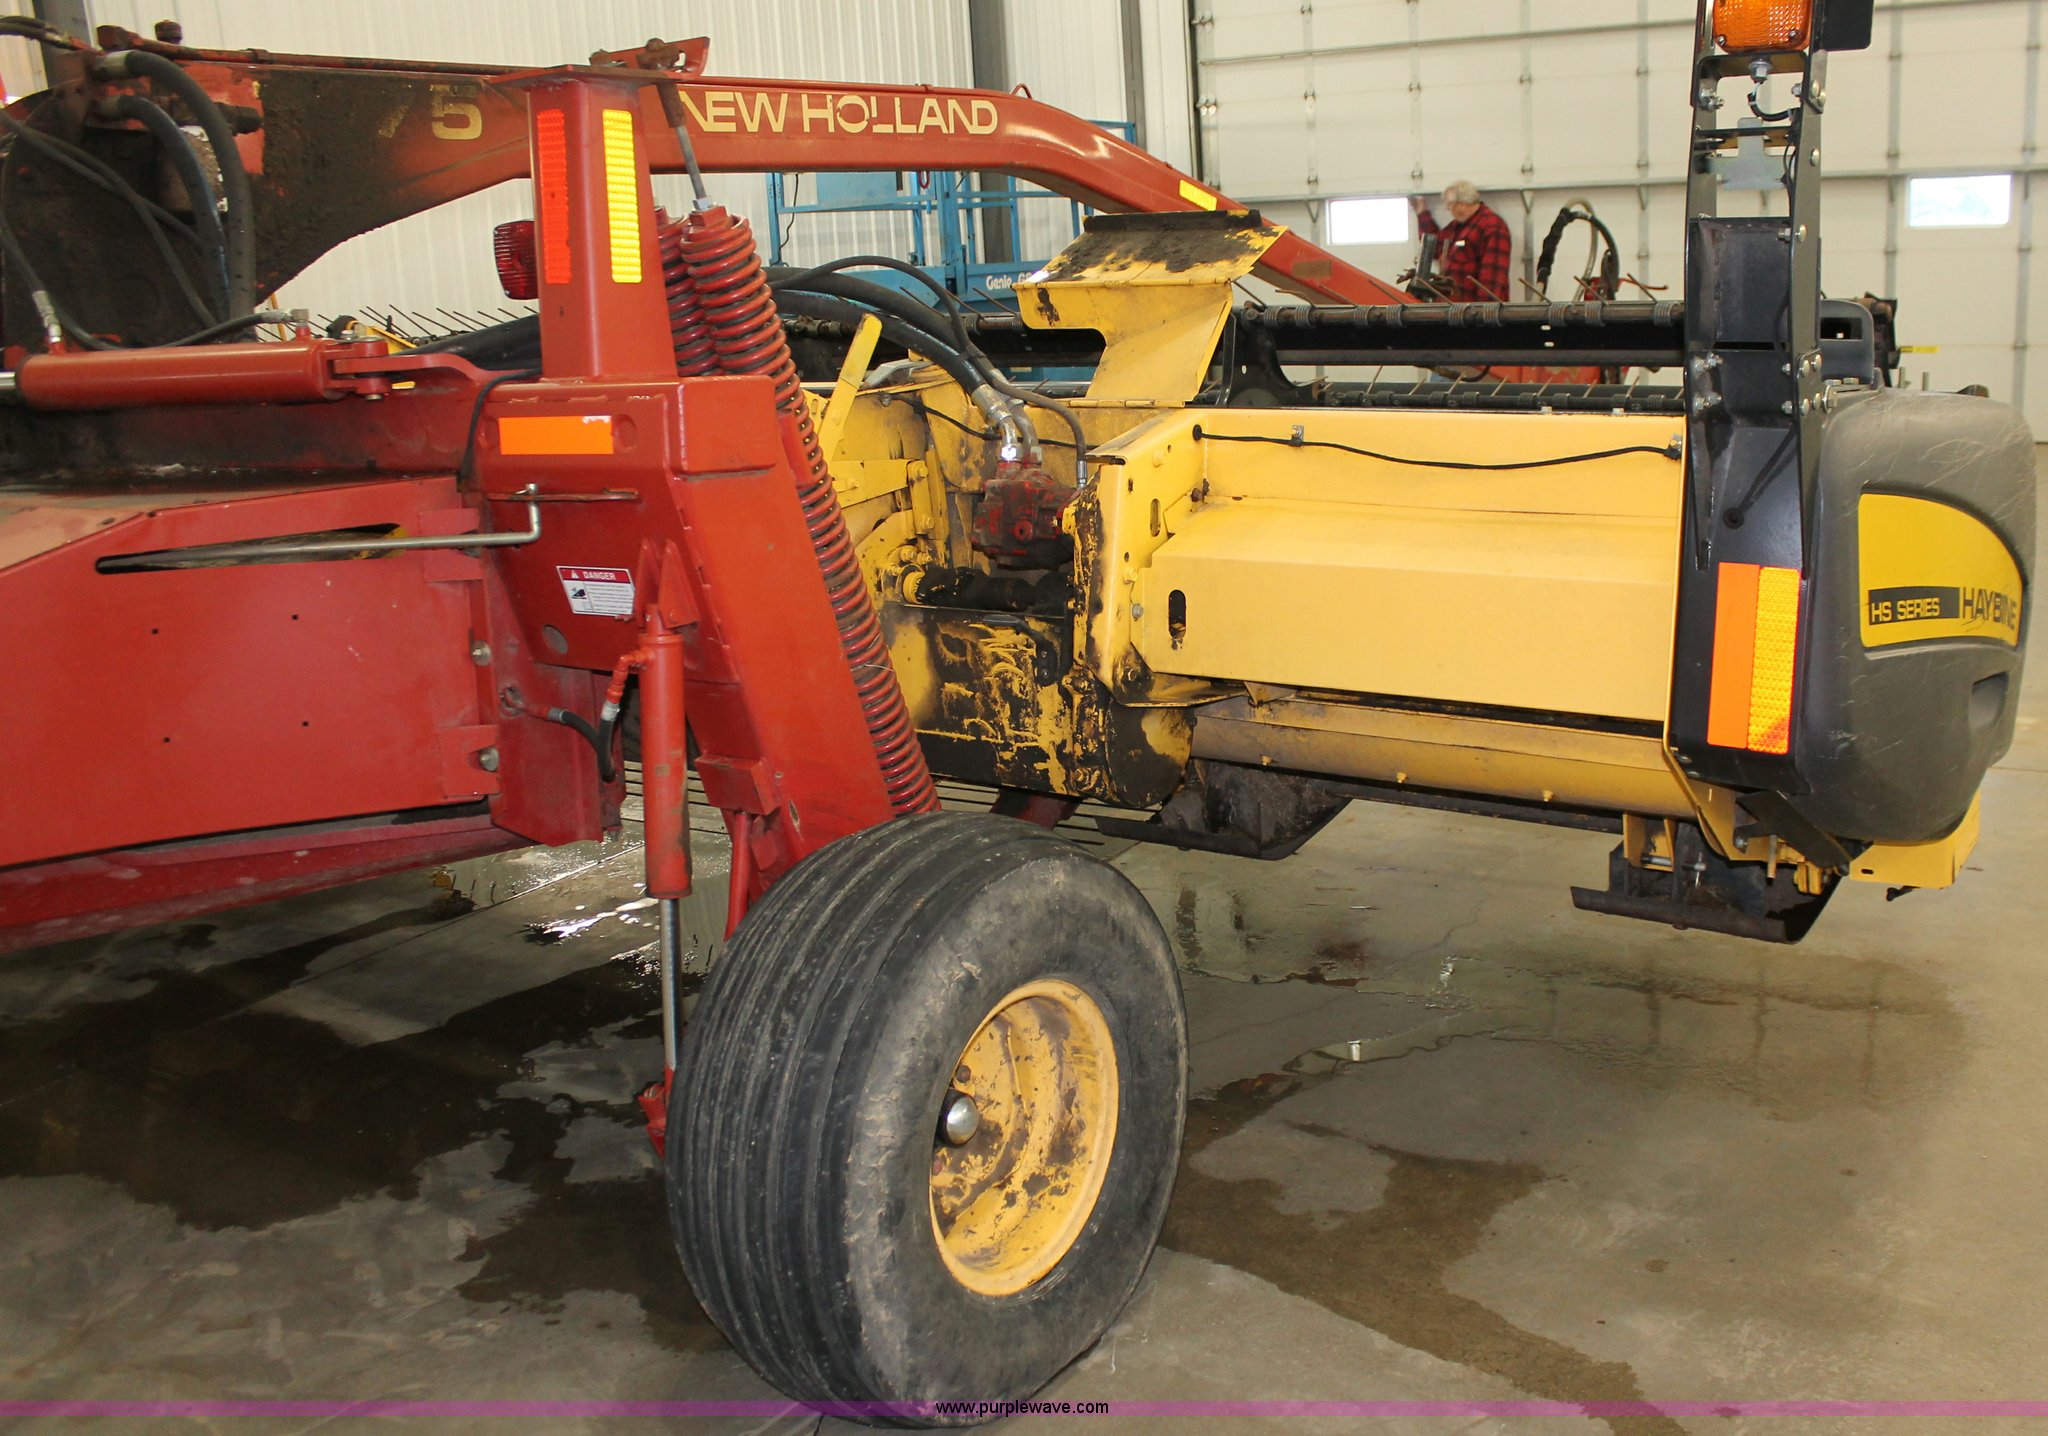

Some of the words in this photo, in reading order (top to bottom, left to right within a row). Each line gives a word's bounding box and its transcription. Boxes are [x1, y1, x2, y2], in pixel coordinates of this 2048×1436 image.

[678, 91, 788, 133] NEW
[801, 93, 999, 135] HOLLAND
[986, 274, 1013, 290] Genie
[582, 571, 617, 580] DANGER
[1871, 601, 1892, 623] HS
[1897, 597, 1941, 620] SERIES
[1962, 587, 2018, 631] HAYBINE
